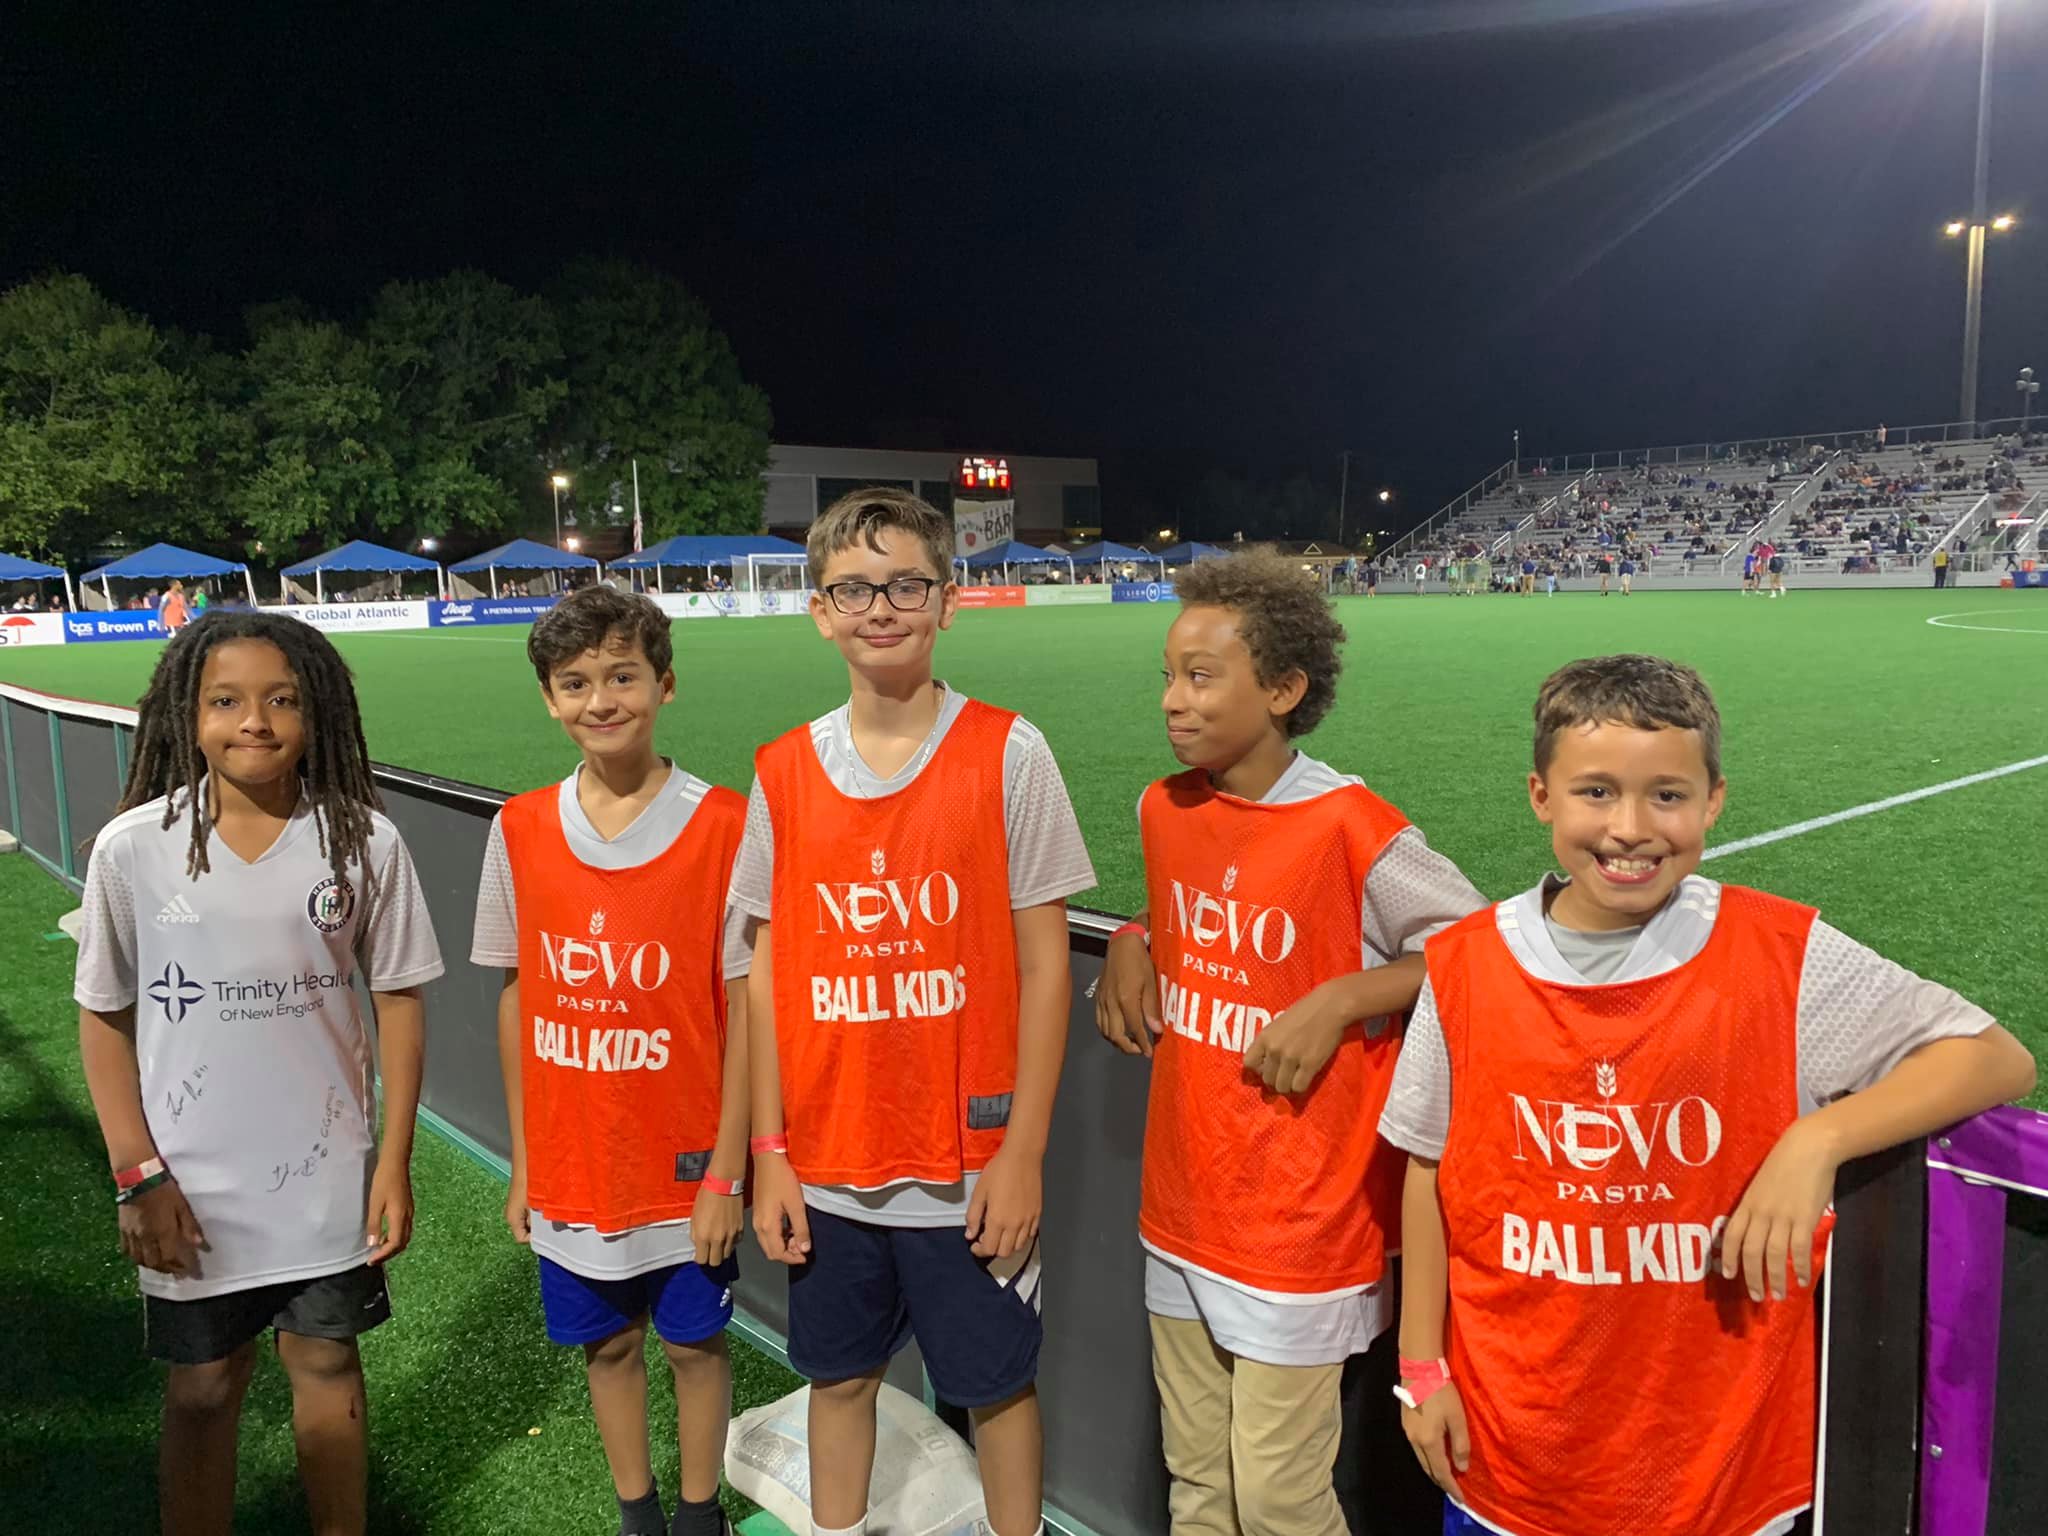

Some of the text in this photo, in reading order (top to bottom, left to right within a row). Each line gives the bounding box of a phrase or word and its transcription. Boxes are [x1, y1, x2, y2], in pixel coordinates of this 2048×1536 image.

[985, 513, 1011, 542] BAR
[305, 605, 409, 621] Global Atlantic
[98, 621, 144, 634] Brown
[157, 913, 200, 923] adidas
[846, 939, 926, 959] PASTA
[1183, 952, 1250, 986] PASTA
[212, 979, 288, 1002] Trinity
[811, 963, 967, 1022] BALL KIDS
[220, 995, 324, 1022] Of New England
[556, 994, 629, 1014] PASTA
[1208, 998, 1287, 1054] KID
[534, 1015, 672, 1073] BALL KIDS
[1556, 1181, 1676, 1204] PASTA
[1502, 1211, 1623, 1286] BALL
